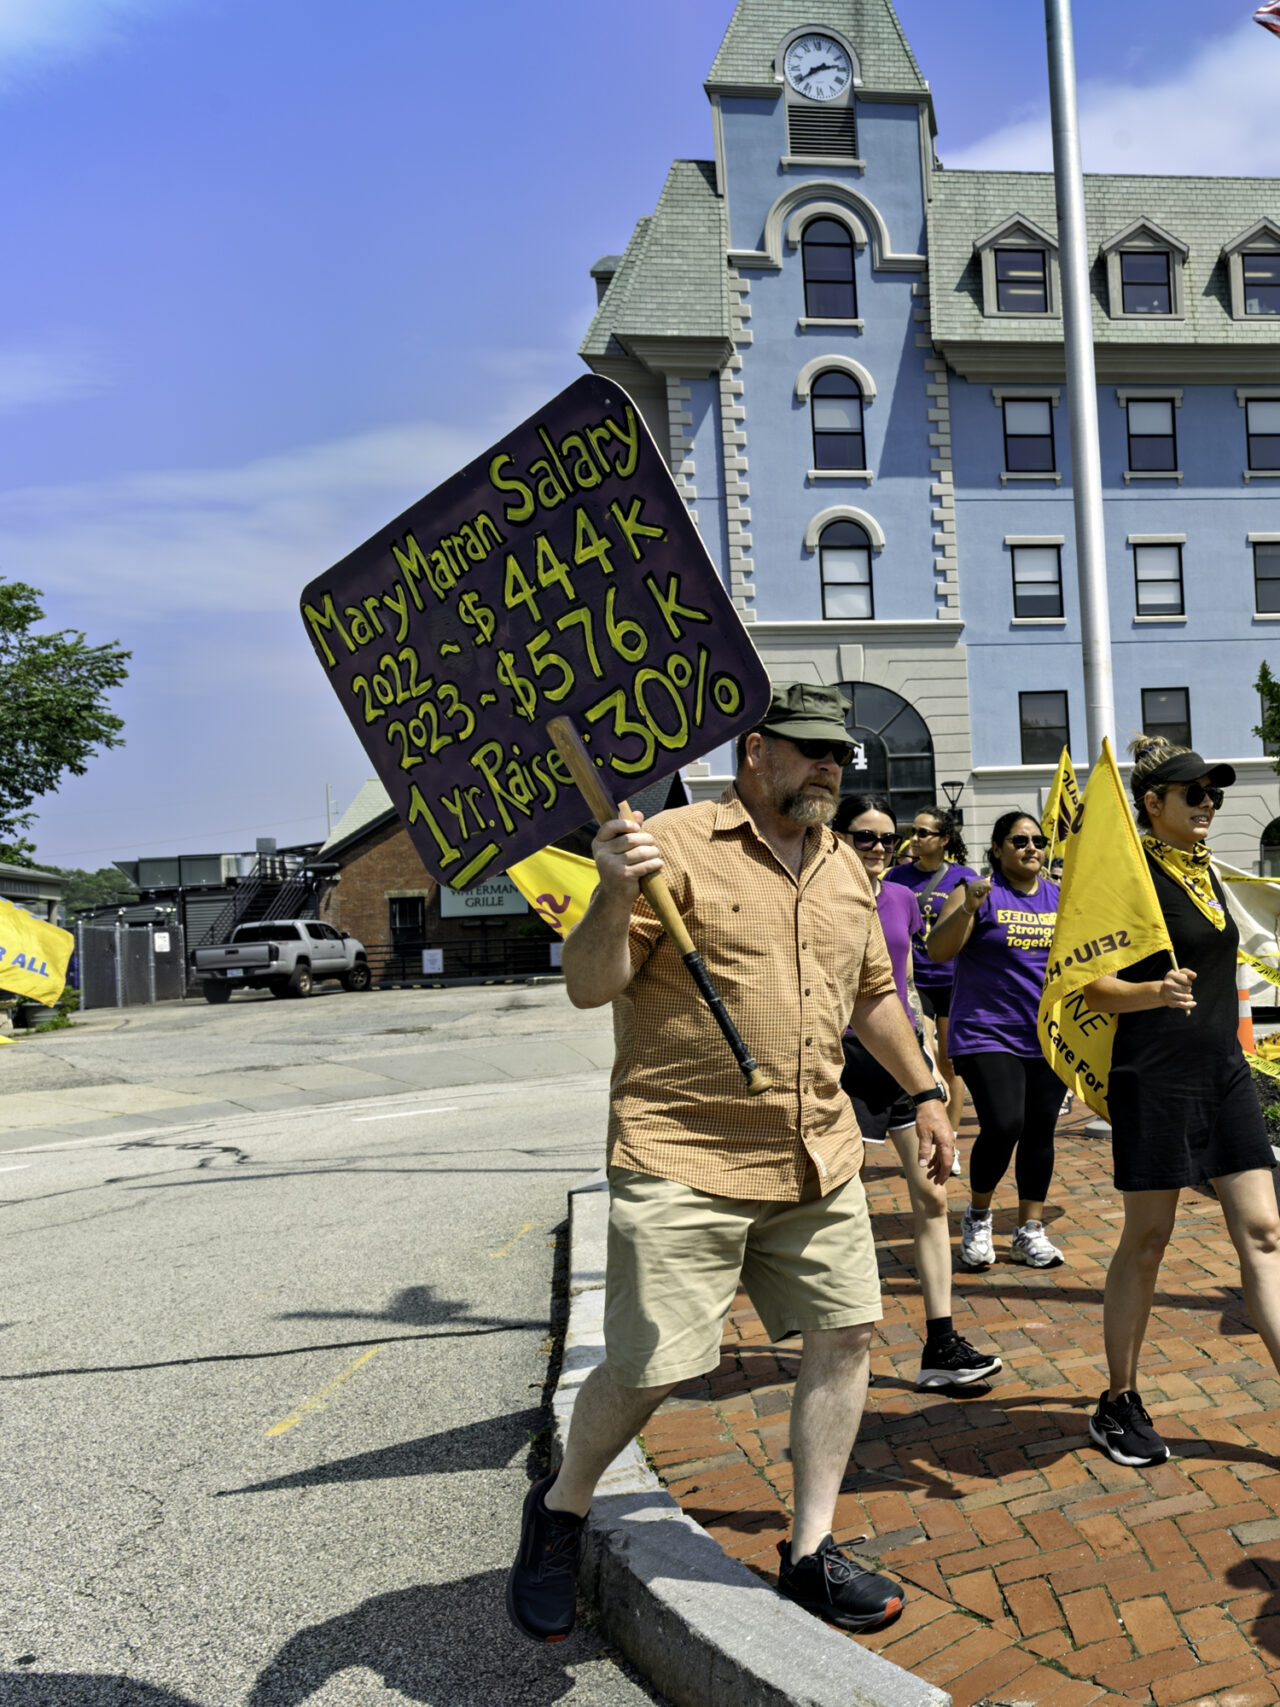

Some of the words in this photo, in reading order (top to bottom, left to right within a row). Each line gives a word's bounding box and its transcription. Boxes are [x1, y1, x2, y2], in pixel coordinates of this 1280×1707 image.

[303, 583, 409, 669] Mary
[393, 511, 503, 611] Marran
[489, 405, 640, 522] Salary
[352, 647, 433, 725] 2022
[387, 683, 476, 773] 2023
[496, 587, 650, 721] $576
[409, 784, 462, 868] 1
[465, 896, 504, 908] GRILLE
[1000, 911, 1036, 923] SEIU
[12, 953, 49, 978] ALL
[1047, 1020, 1076, 1064] Care
[1075, 1058, 1104, 1093] For
